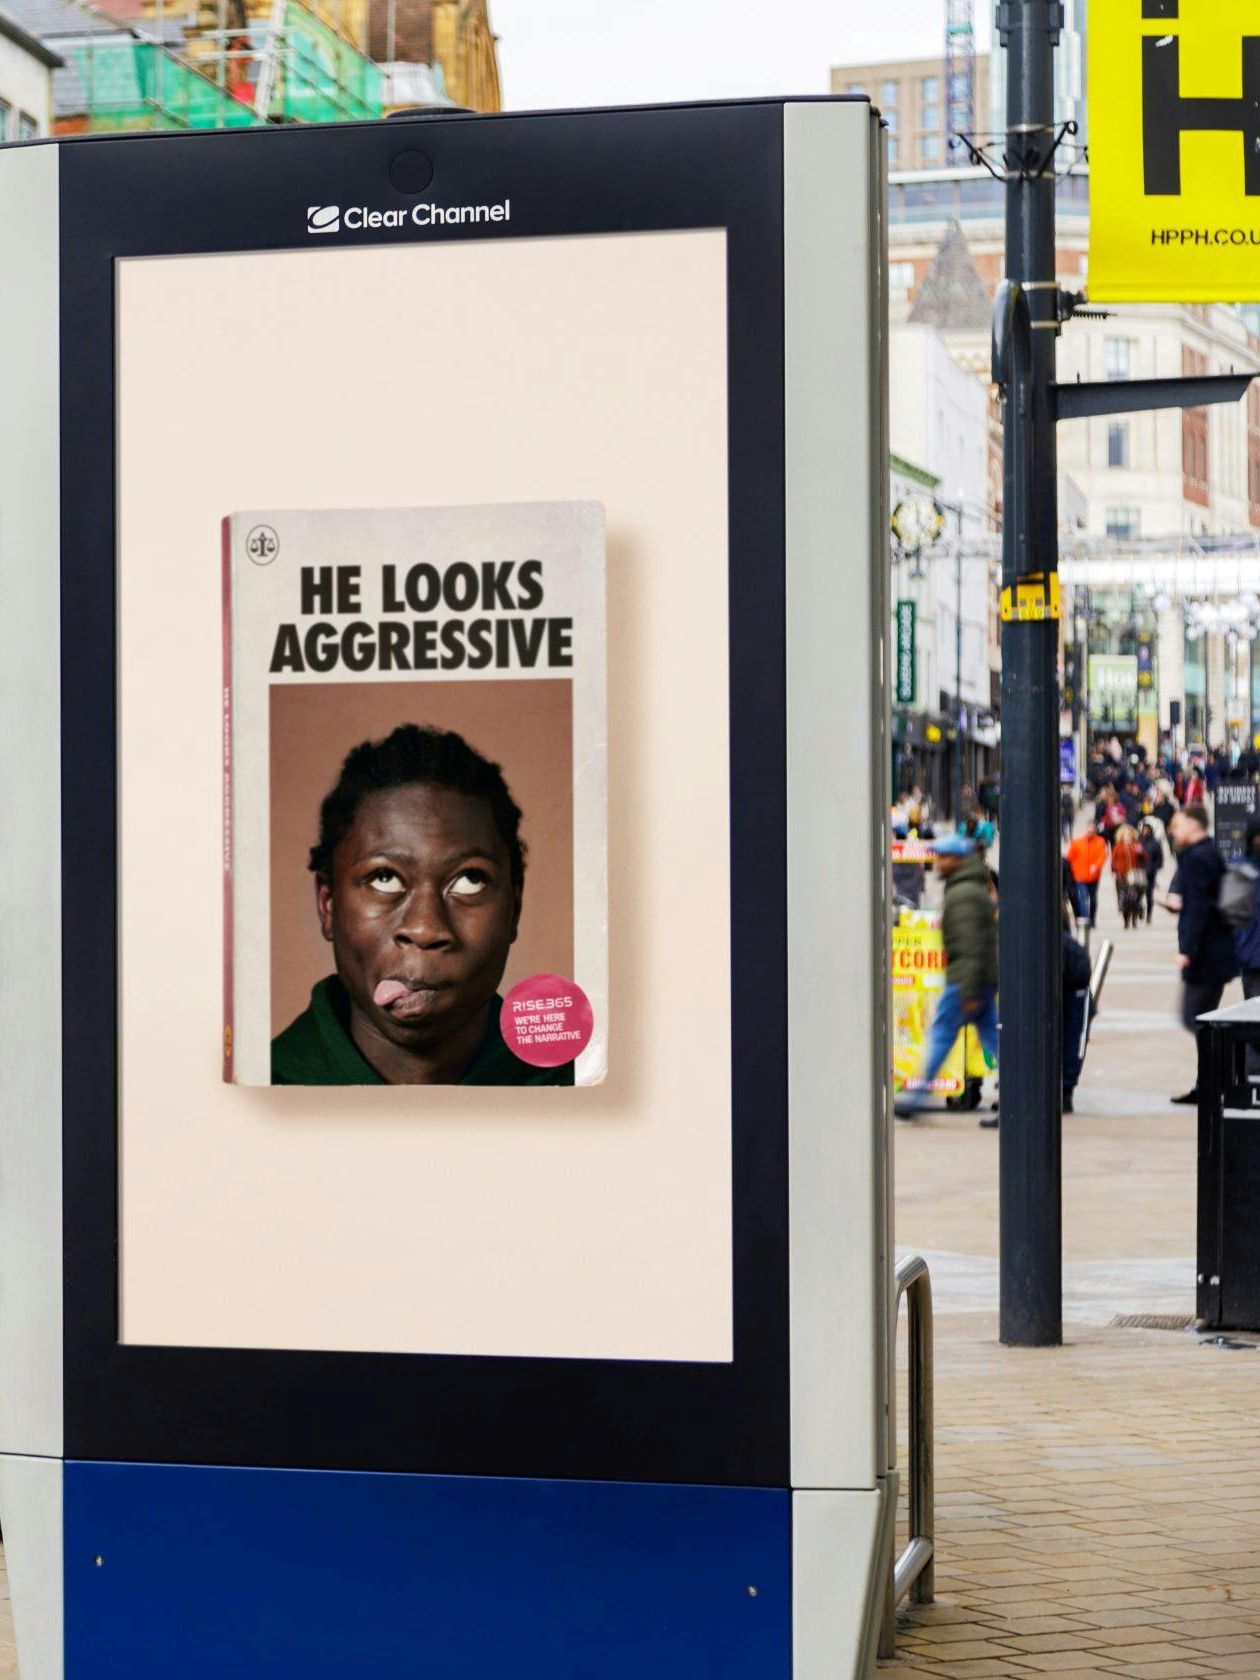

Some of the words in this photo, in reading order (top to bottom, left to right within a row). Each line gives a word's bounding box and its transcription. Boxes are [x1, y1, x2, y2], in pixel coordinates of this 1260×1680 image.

[343, 207, 408, 229] Clear
[412, 199, 510, 226] Channel
[300, 565, 362, 615] HE
[382, 560, 545, 613] LOOKS
[268, 617, 574, 673] AGGRESSIVE
[513, 996, 573, 1012] RISE365
[514, 1015, 542, 1025] WE'RE
[543, 1012, 566, 1022] HERE
[516, 1026, 527, 1034] TO
[528, 1023, 563, 1034] CHANGE
[517, 1035, 533, 1044] THE
[535, 1030, 581, 1043] NARRATIVE
